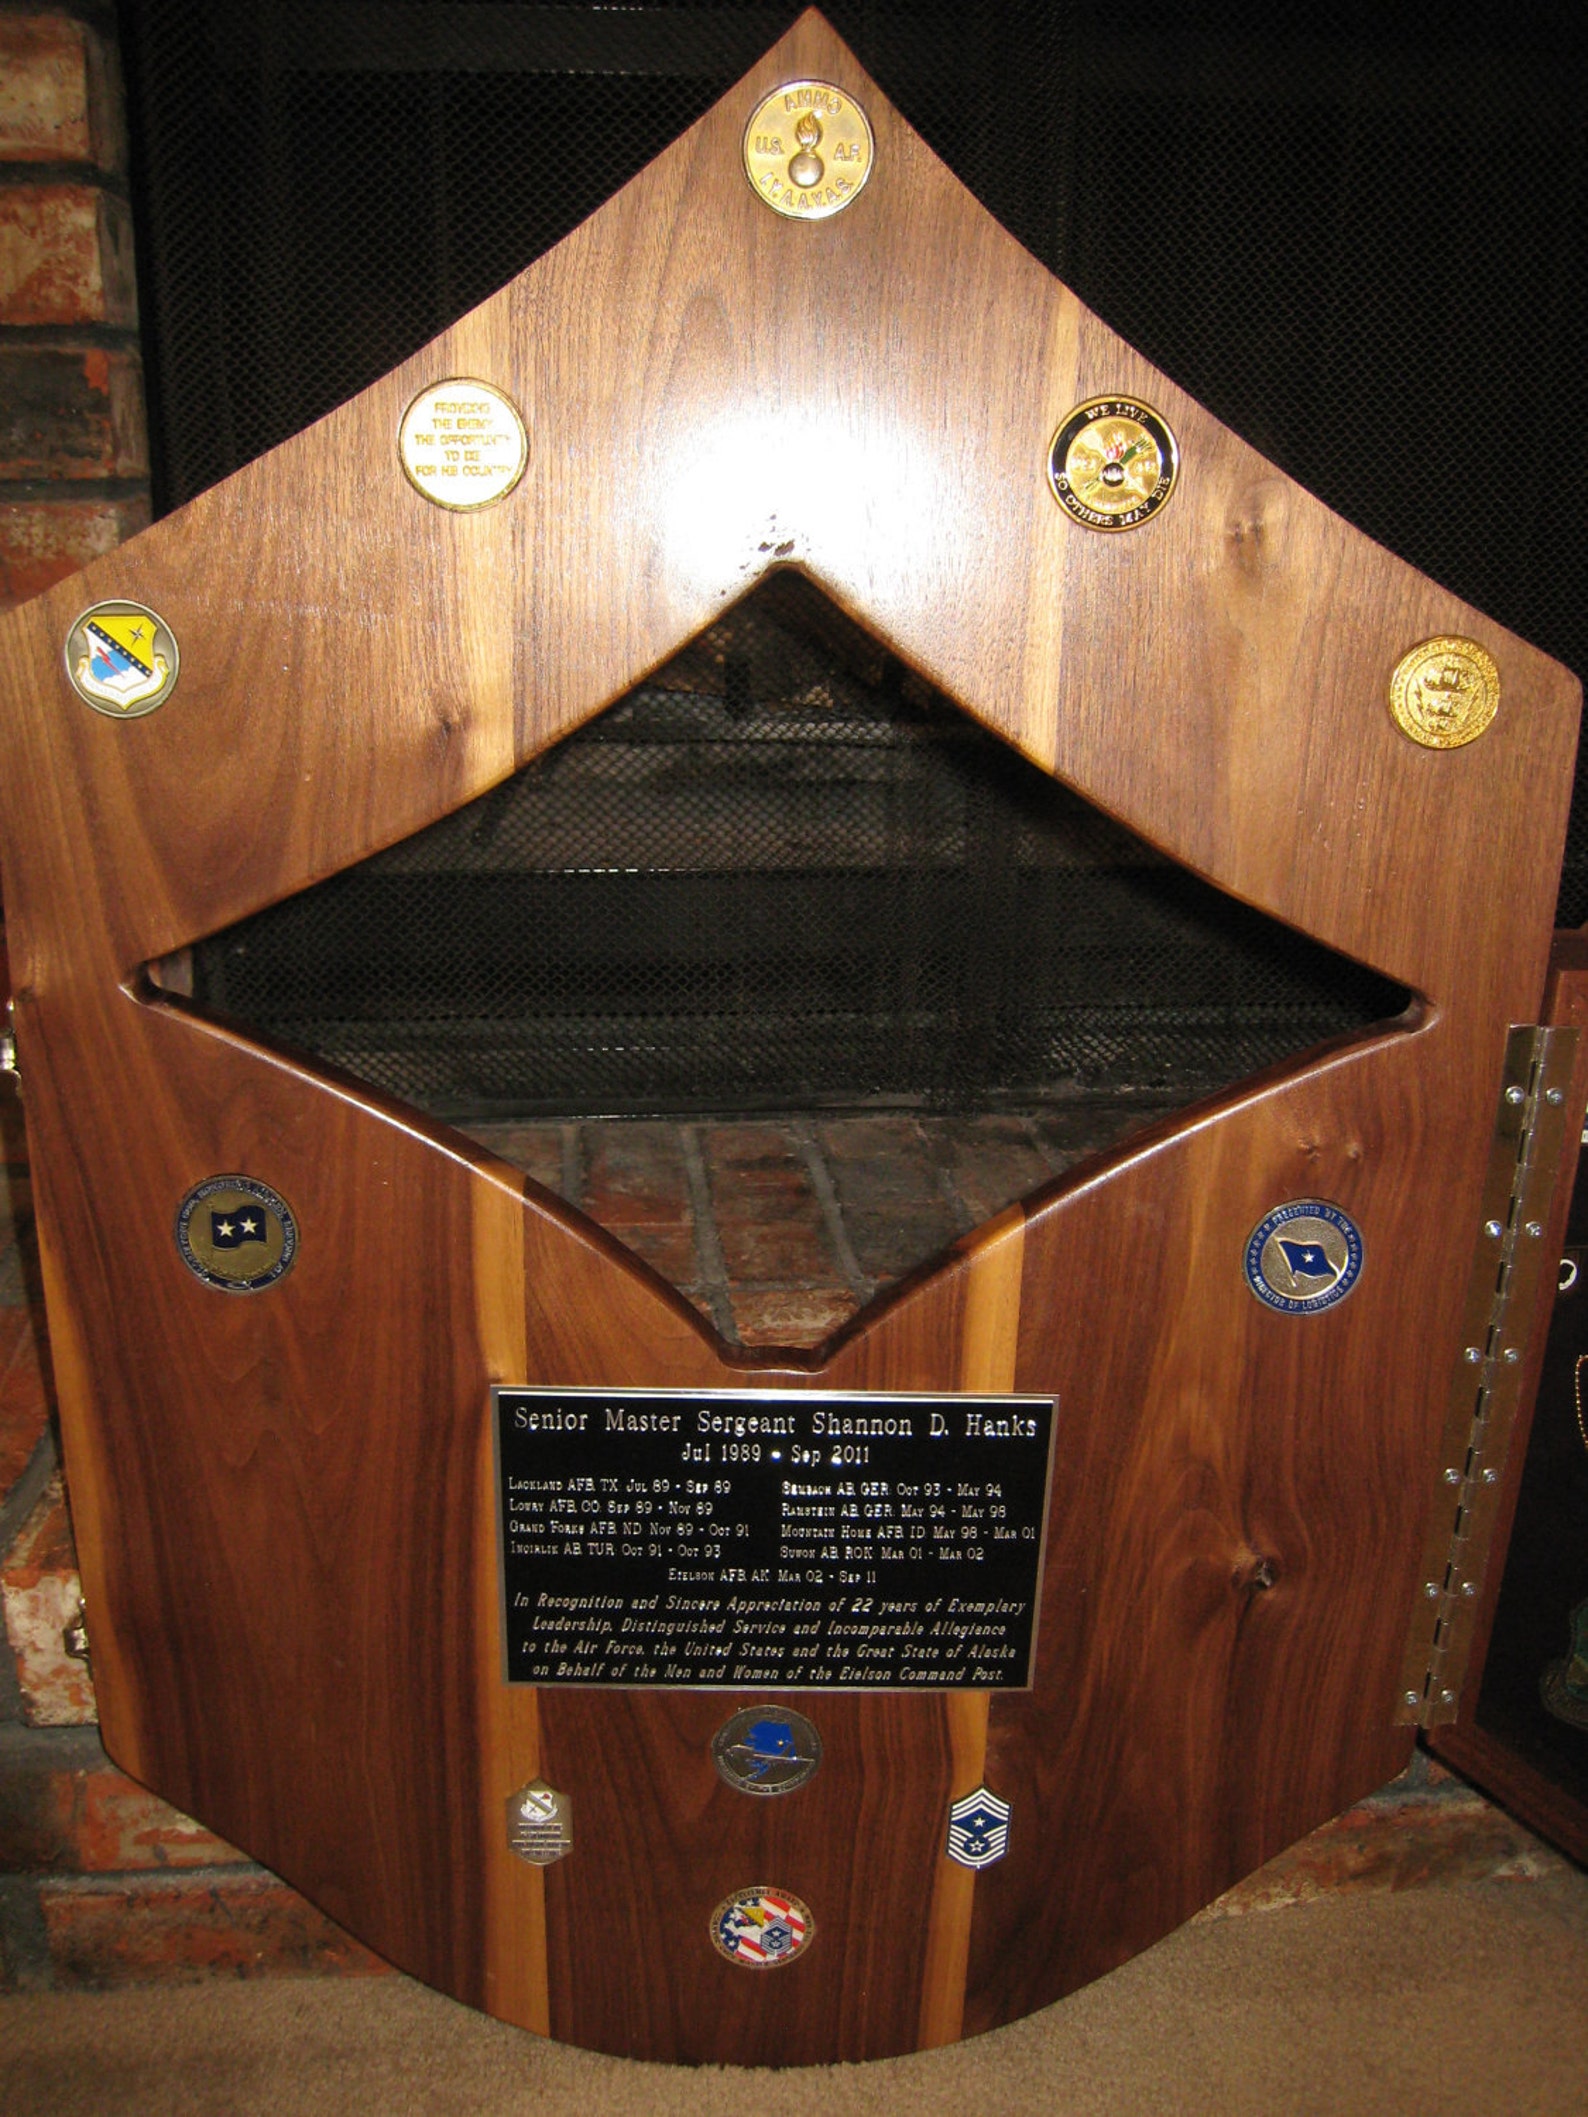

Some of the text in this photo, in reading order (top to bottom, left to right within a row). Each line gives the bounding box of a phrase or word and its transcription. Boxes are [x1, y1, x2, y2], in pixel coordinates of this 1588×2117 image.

[784, 88, 843, 115] AMMO
[1084, 403, 1149, 423] WE LIVE
[431, 417, 453, 430] THE
[414, 433, 435, 446] THE
[444, 449, 460, 462] TO
[415, 464, 436, 477] FOR
[1054, 472, 1171, 526] SO OTHERS MAY DIE
[514, 1406, 1037, 1438] Senior Master Sergeant Shannon D. Hanks
[681, 1442, 869, 1468] Jul 1989 Sep 2011
[652, 1478, 670, 1493] 89
[713, 1479, 732, 1495] 89
[923, 1482, 941, 1497] 93
[985, 1482, 1002, 1498] 94
[635, 1500, 653, 1515] 89
[695, 1501, 714, 1516] 89
[929, 1503, 946, 1518] 94
[989, 1505, 1007, 1519] 98
[676, 1522, 694, 1537] 89
[735, 1523, 750, 1537] 91
[960, 1525, 978, 1540] 98
[1021, 1526, 1036, 1540] 01
[648, 1543, 662, 1558] 91
[704, 1544, 721, 1559] 93
[909, 1546, 923, 1560] 01
[966, 1546, 984, 1561] 02
[805, 1569, 824, 1584] 02
[514, 1591, 1026, 1616] In Recognition and Sincere Appreciation of 22 years of Exemplary
[620, 1617, 727, 1636] Distinguished
[732, 1619, 786, 1635] Service
[793, 1619, 821, 1635] and
[827, 1620, 924, 1639] Incomparable
[929, 1621, 1006, 1640] Allegiance
[522, 1641, 537, 1653] to
[544, 1639, 568, 1654] the
[573, 1639, 598, 1655] Air
[653, 1641, 677, 1657] the
[684, 1641, 733, 1657] United
[739, 1642, 785, 1658] States
[792, 1643, 820, 1658] and
[826, 1643, 850, 1658] the
[856, 1643, 895, 1658] Great
[901, 1643, 940, 1659] State
[945, 1643, 964, 1658] of
[967, 1644, 1016, 1659] Alaska
[533, 1665, 549, 1676] on
[556, 1661, 606, 1677] Behalf
[610, 1663, 628, 1677] of
[634, 1663, 657, 1678] the
[664, 1663, 692, 1678] Men
[698, 1664, 727, 1679] and
[733, 1664, 779, 1680] Women
[786, 1665, 804, 1680] of
[809, 1665, 833, 1681] the
[839, 1665, 892, 1681] Eielson
[899, 1666, 966, 1681] Command
